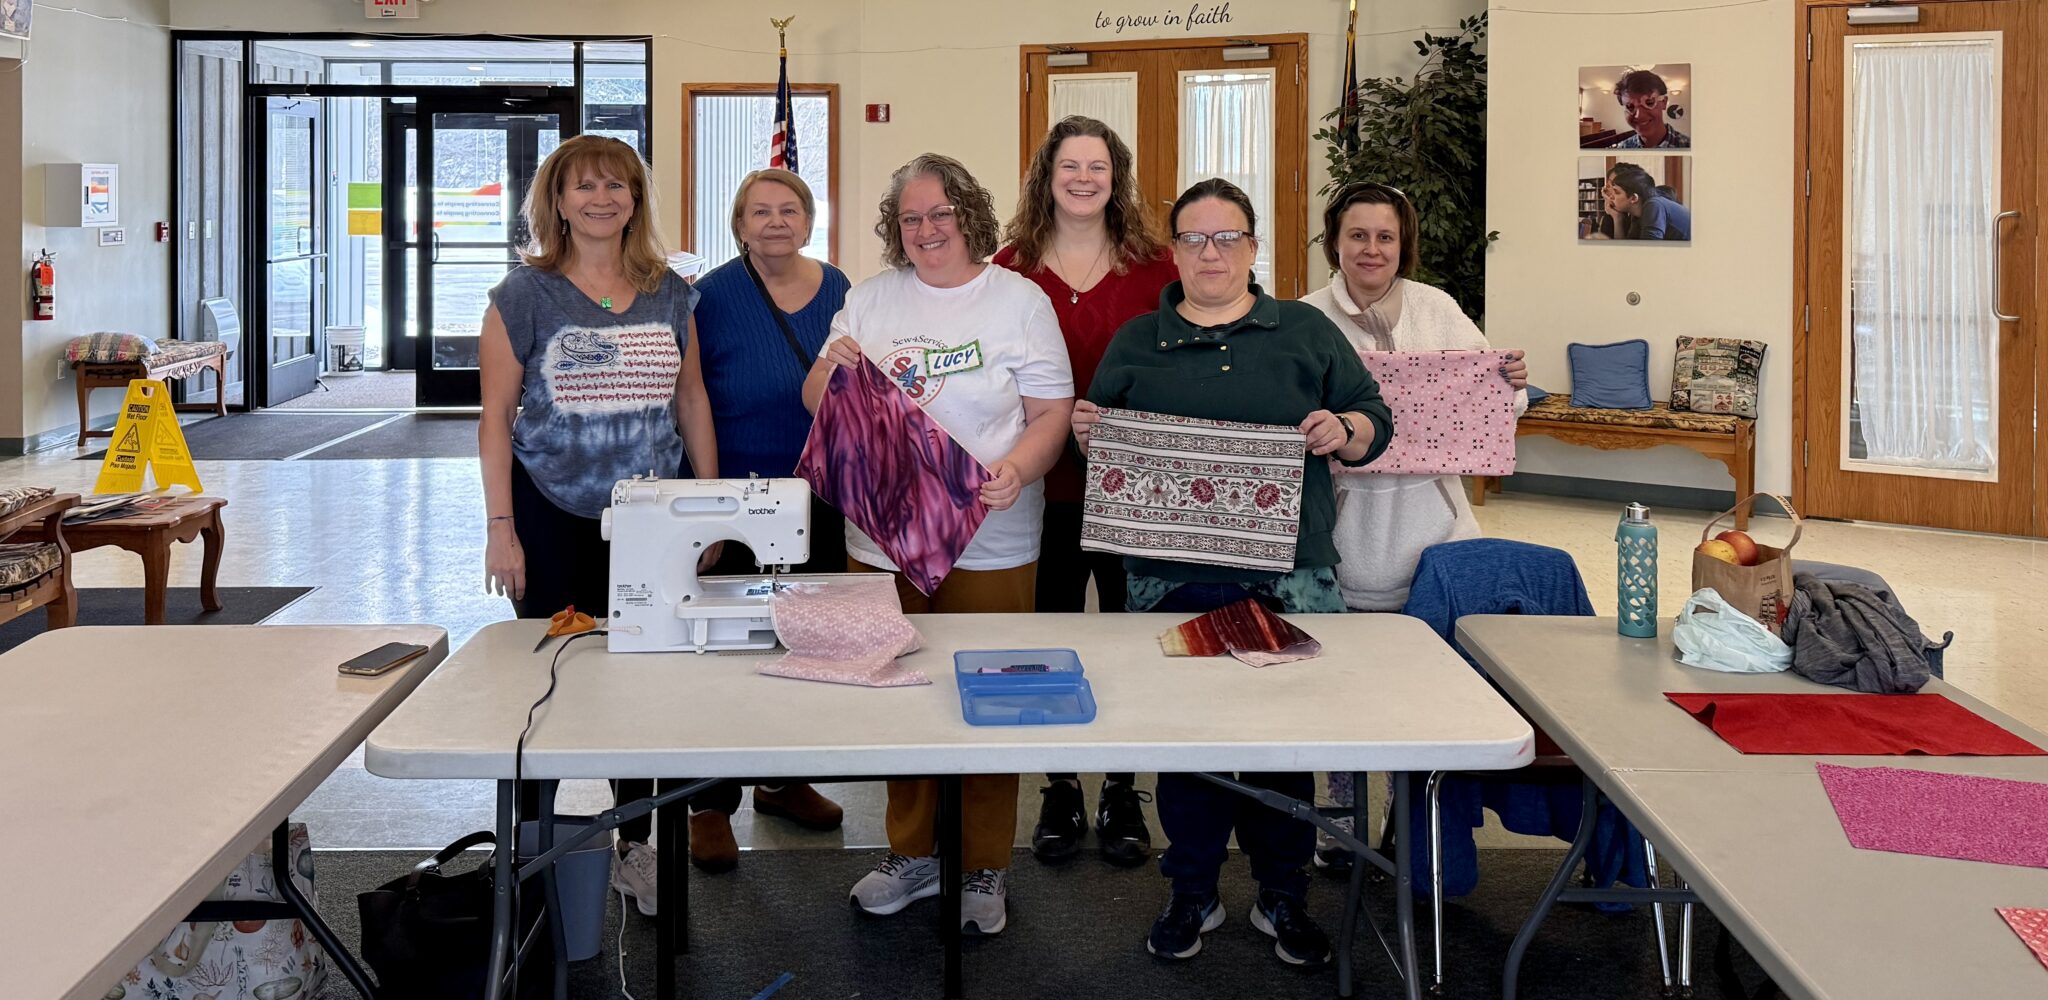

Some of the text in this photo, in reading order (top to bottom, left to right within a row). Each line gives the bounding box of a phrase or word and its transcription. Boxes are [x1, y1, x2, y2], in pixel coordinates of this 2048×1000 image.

[1095, 1, 1234, 34] to grow in faith
[892, 334, 949, 350] Sew4Service
[933, 348, 975, 370] LUCY
[128, 404, 150, 413] CAUTION
[135, 413, 148, 421] Floor
[748, 508, 777, 516] brother
